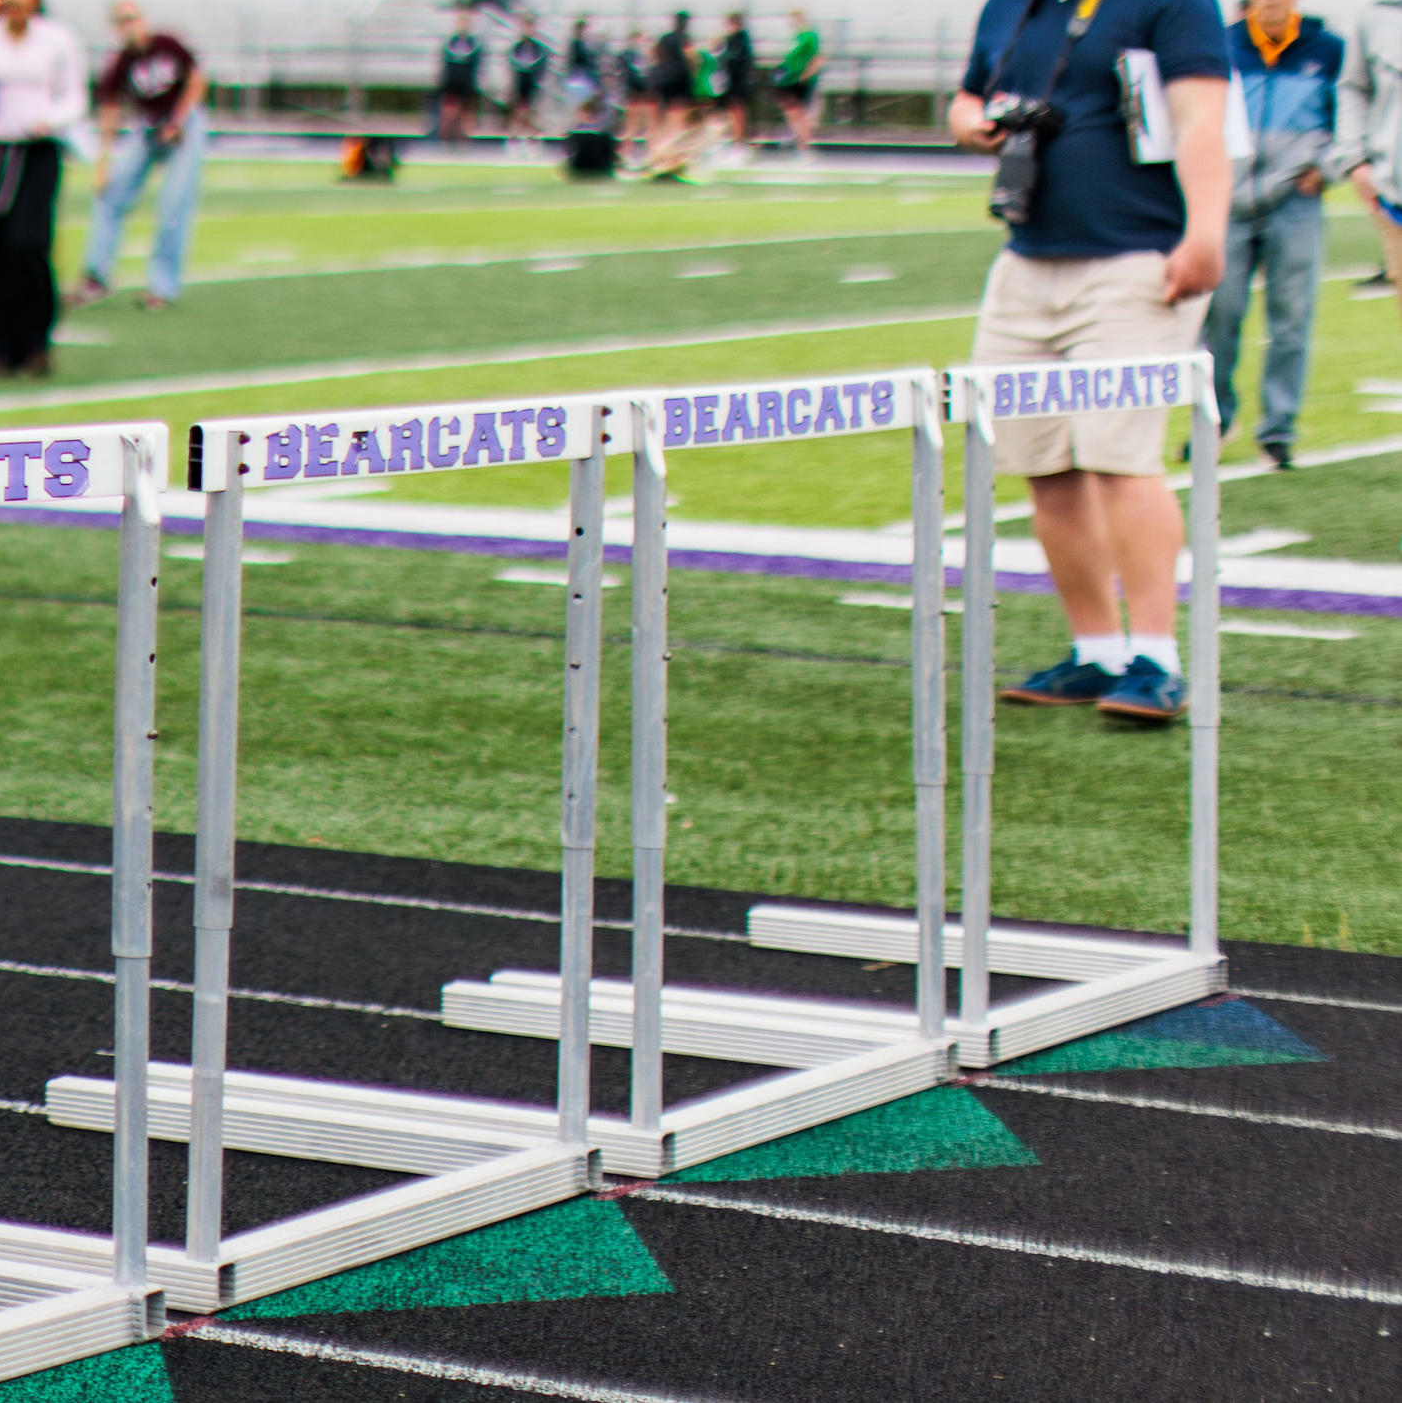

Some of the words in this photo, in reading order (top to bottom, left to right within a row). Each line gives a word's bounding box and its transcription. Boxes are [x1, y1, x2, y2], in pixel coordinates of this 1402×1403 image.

[663, 380, 894, 447] BEARCATS
[993, 363, 1179, 416] BEARCATS
[263, 406, 566, 480] BEARCATS
